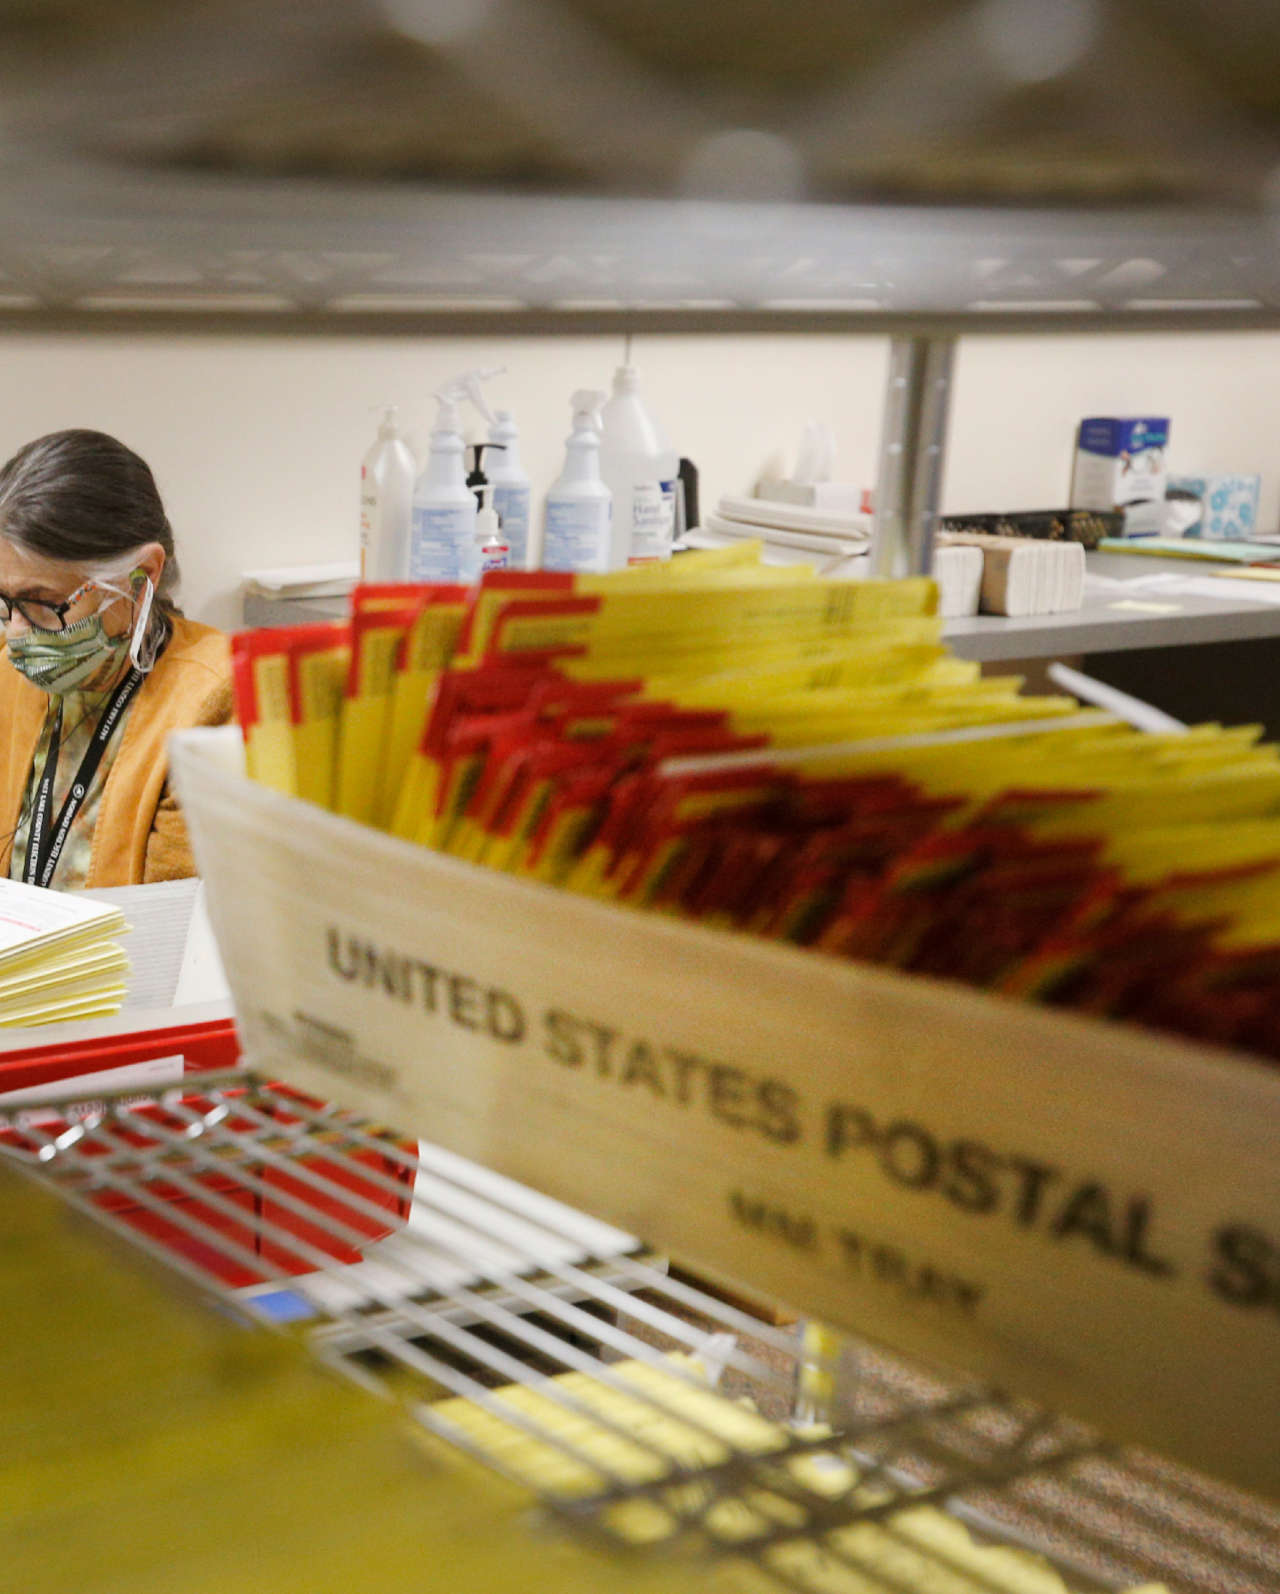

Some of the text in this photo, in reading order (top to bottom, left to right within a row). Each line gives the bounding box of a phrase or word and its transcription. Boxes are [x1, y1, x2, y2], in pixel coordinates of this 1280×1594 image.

[326, 928, 527, 1045] UNITED
[542, 1007, 802, 1147] STATES
[825, 1103, 1177, 1281] POSTAL
[837, 1228, 985, 1314] TRAY
